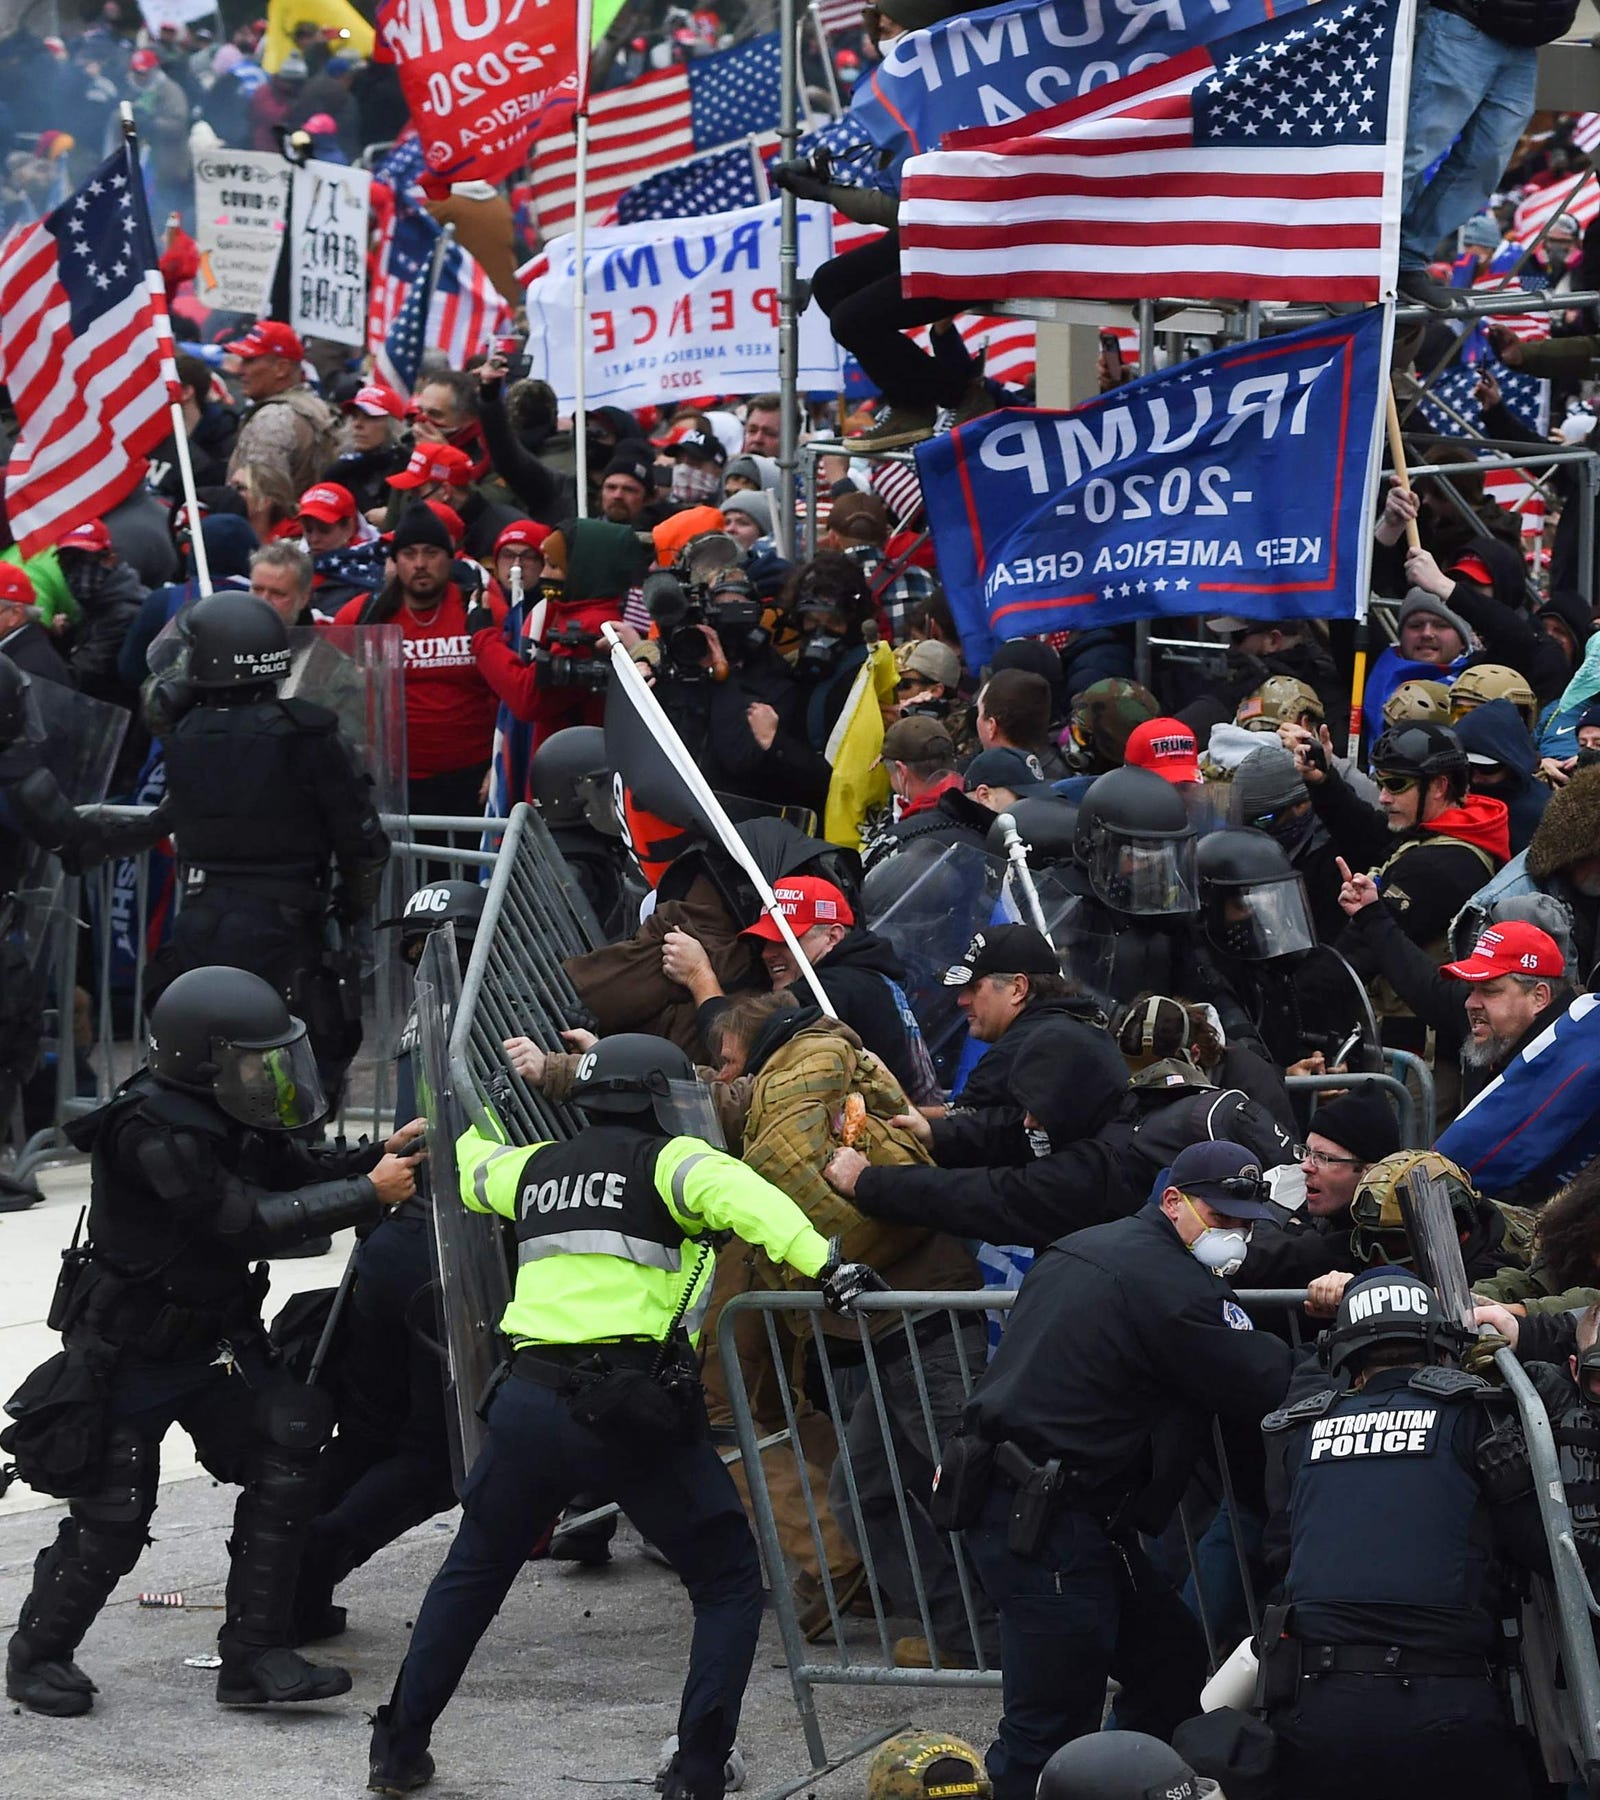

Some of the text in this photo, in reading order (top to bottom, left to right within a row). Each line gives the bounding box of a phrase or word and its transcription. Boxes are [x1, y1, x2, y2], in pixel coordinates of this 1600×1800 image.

[234, 648, 291, 665] U.S. CAPIT
[252, 661, 287, 675] POLICE
[1152, 739, 1193, 754] TRUMP
[403, 888, 451, 918] PDC
[774, 888, 804, 901] MERICA
[1519, 953, 1539, 969] 45
[521, 1171, 627, 1221] POLICE
[1349, 1284, 1429, 1325] MPDC
[1311, 1409, 1437, 1440] METROPOLITAN
[1310, 1430, 1428, 1461] POLICE
[908, 1745, 941, 1776] ALWAYS
